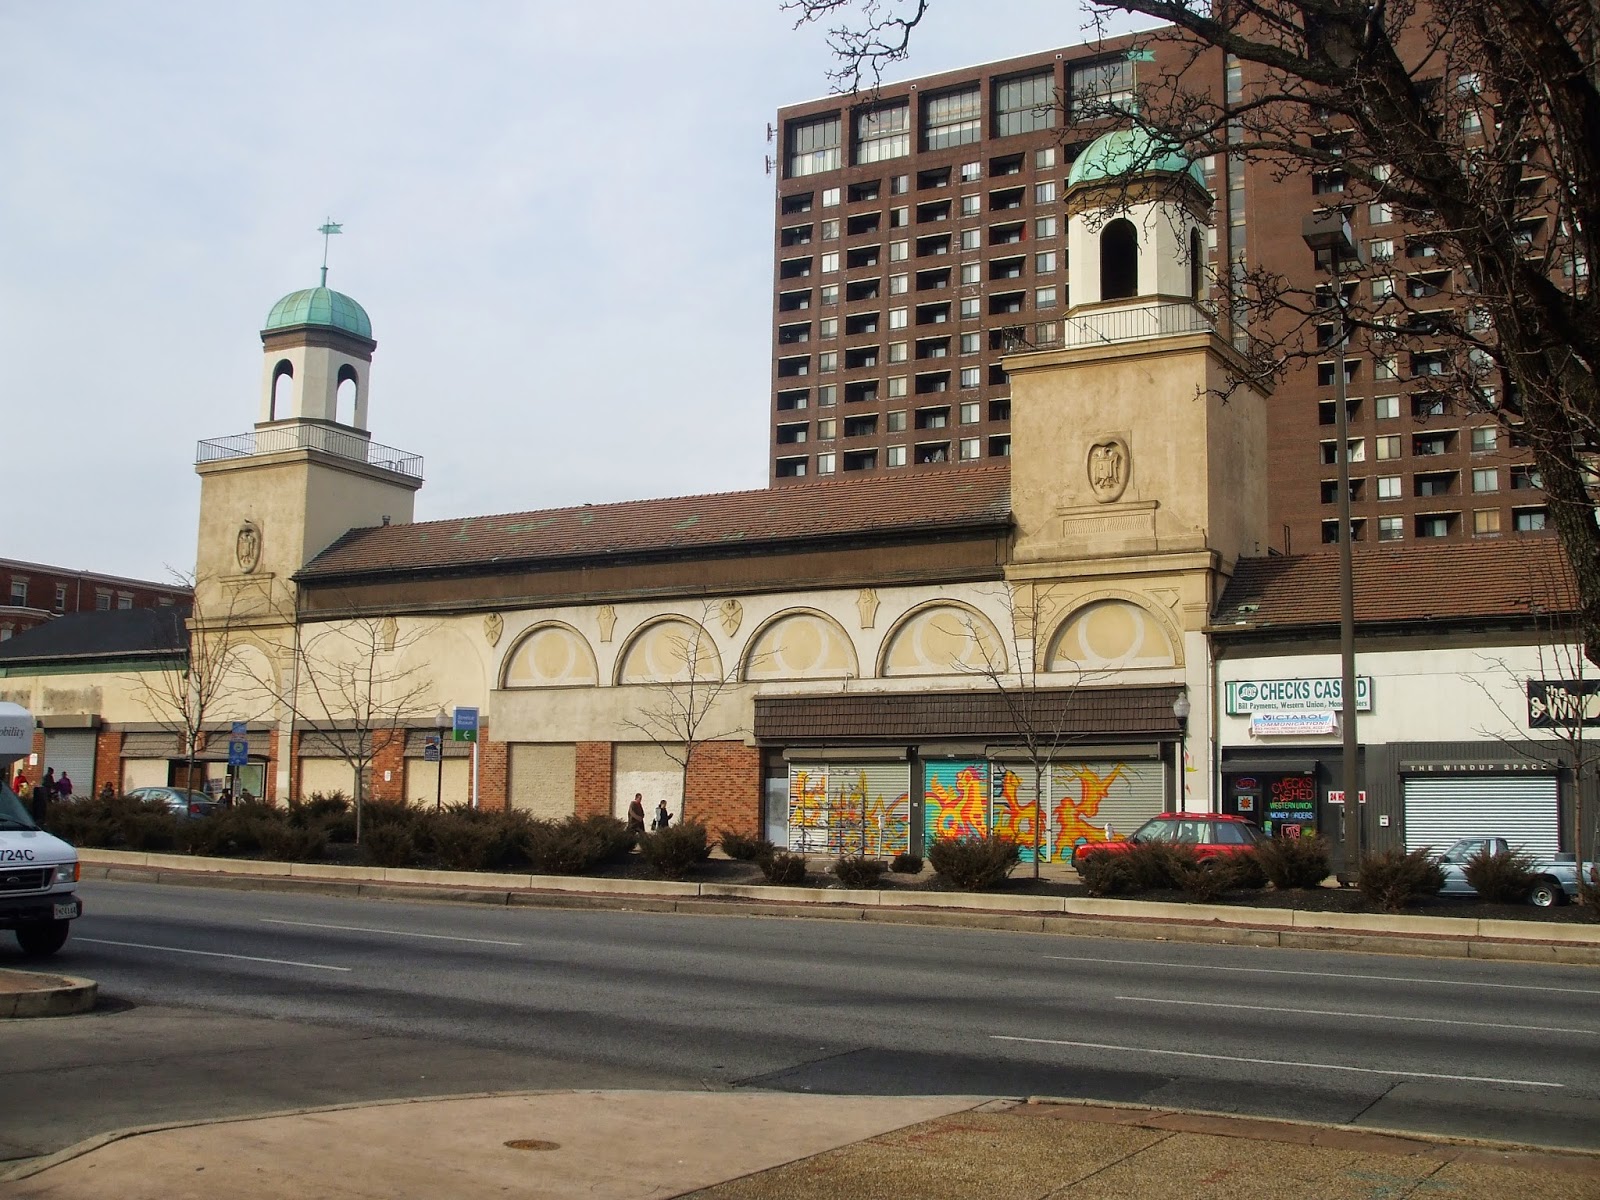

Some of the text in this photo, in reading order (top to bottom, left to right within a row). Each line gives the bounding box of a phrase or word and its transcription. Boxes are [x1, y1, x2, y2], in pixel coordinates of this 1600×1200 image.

[1260, 679, 1367, 700] CHECKS CASD
[1238, 701, 1248, 710] Bill
[1249, 701, 1279, 711] Payments,
[1280, 701, 1304, 709] Western
[1328, 700, 1343, 708] Mone
[1504, 763, 1547, 771] SPACE
[1271, 777, 1313, 794] CHECKS
[1269, 801, 1313, 810] WESTERN UNION
[1270, 811, 1289, 819] MONEY
